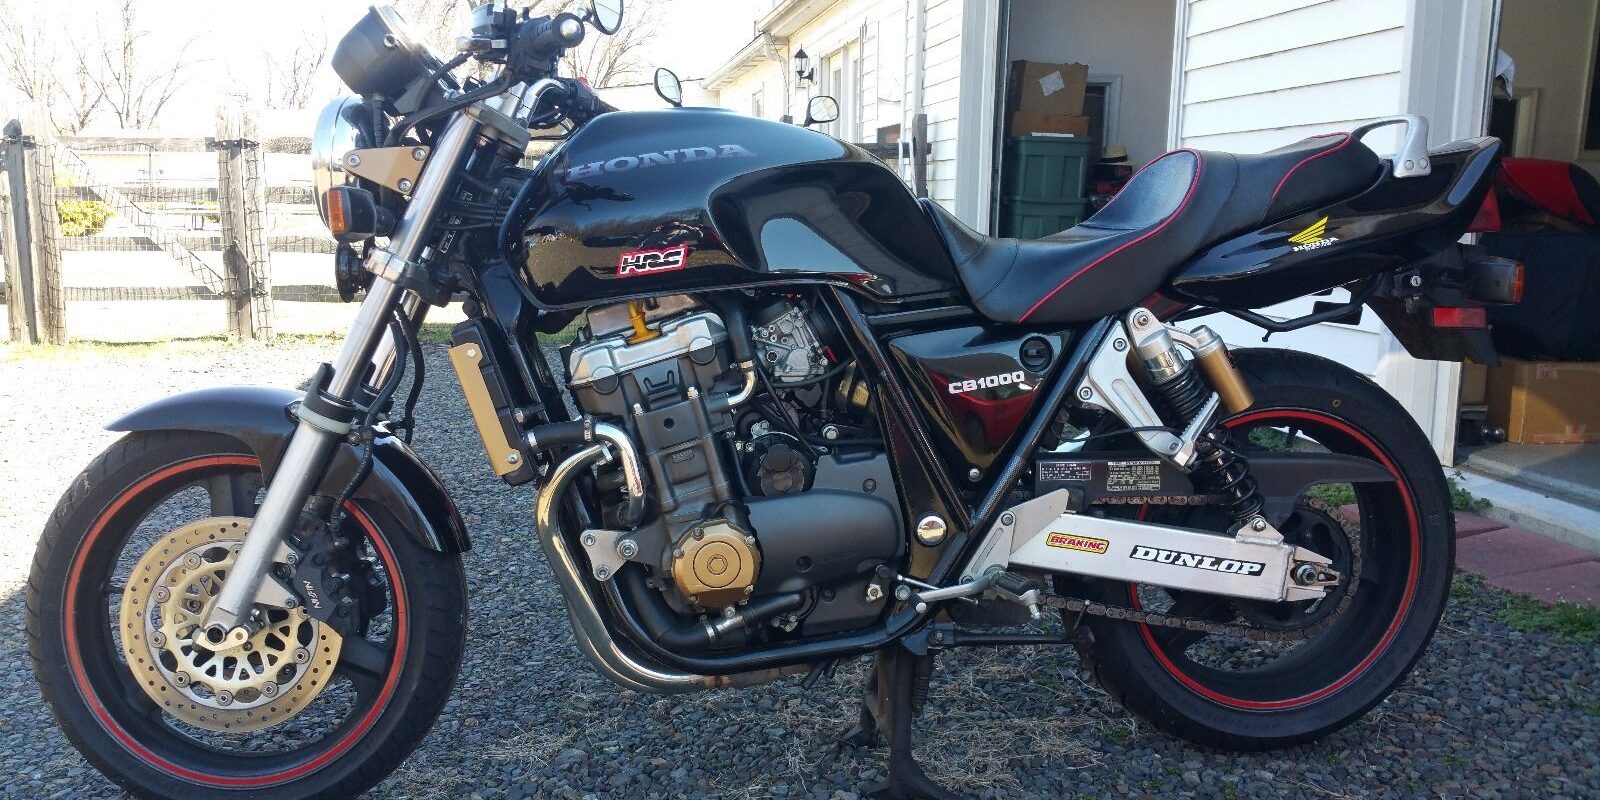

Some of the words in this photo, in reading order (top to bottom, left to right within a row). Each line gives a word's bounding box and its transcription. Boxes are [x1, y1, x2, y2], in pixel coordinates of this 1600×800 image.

[566, 144, 756, 181] HONDA
[620, 248, 684, 274] HRC
[948, 370, 1025, 394] CB1000
[1049, 535, 1105, 551] BRAKING
[1133, 546, 1262, 576] DUNLOP
